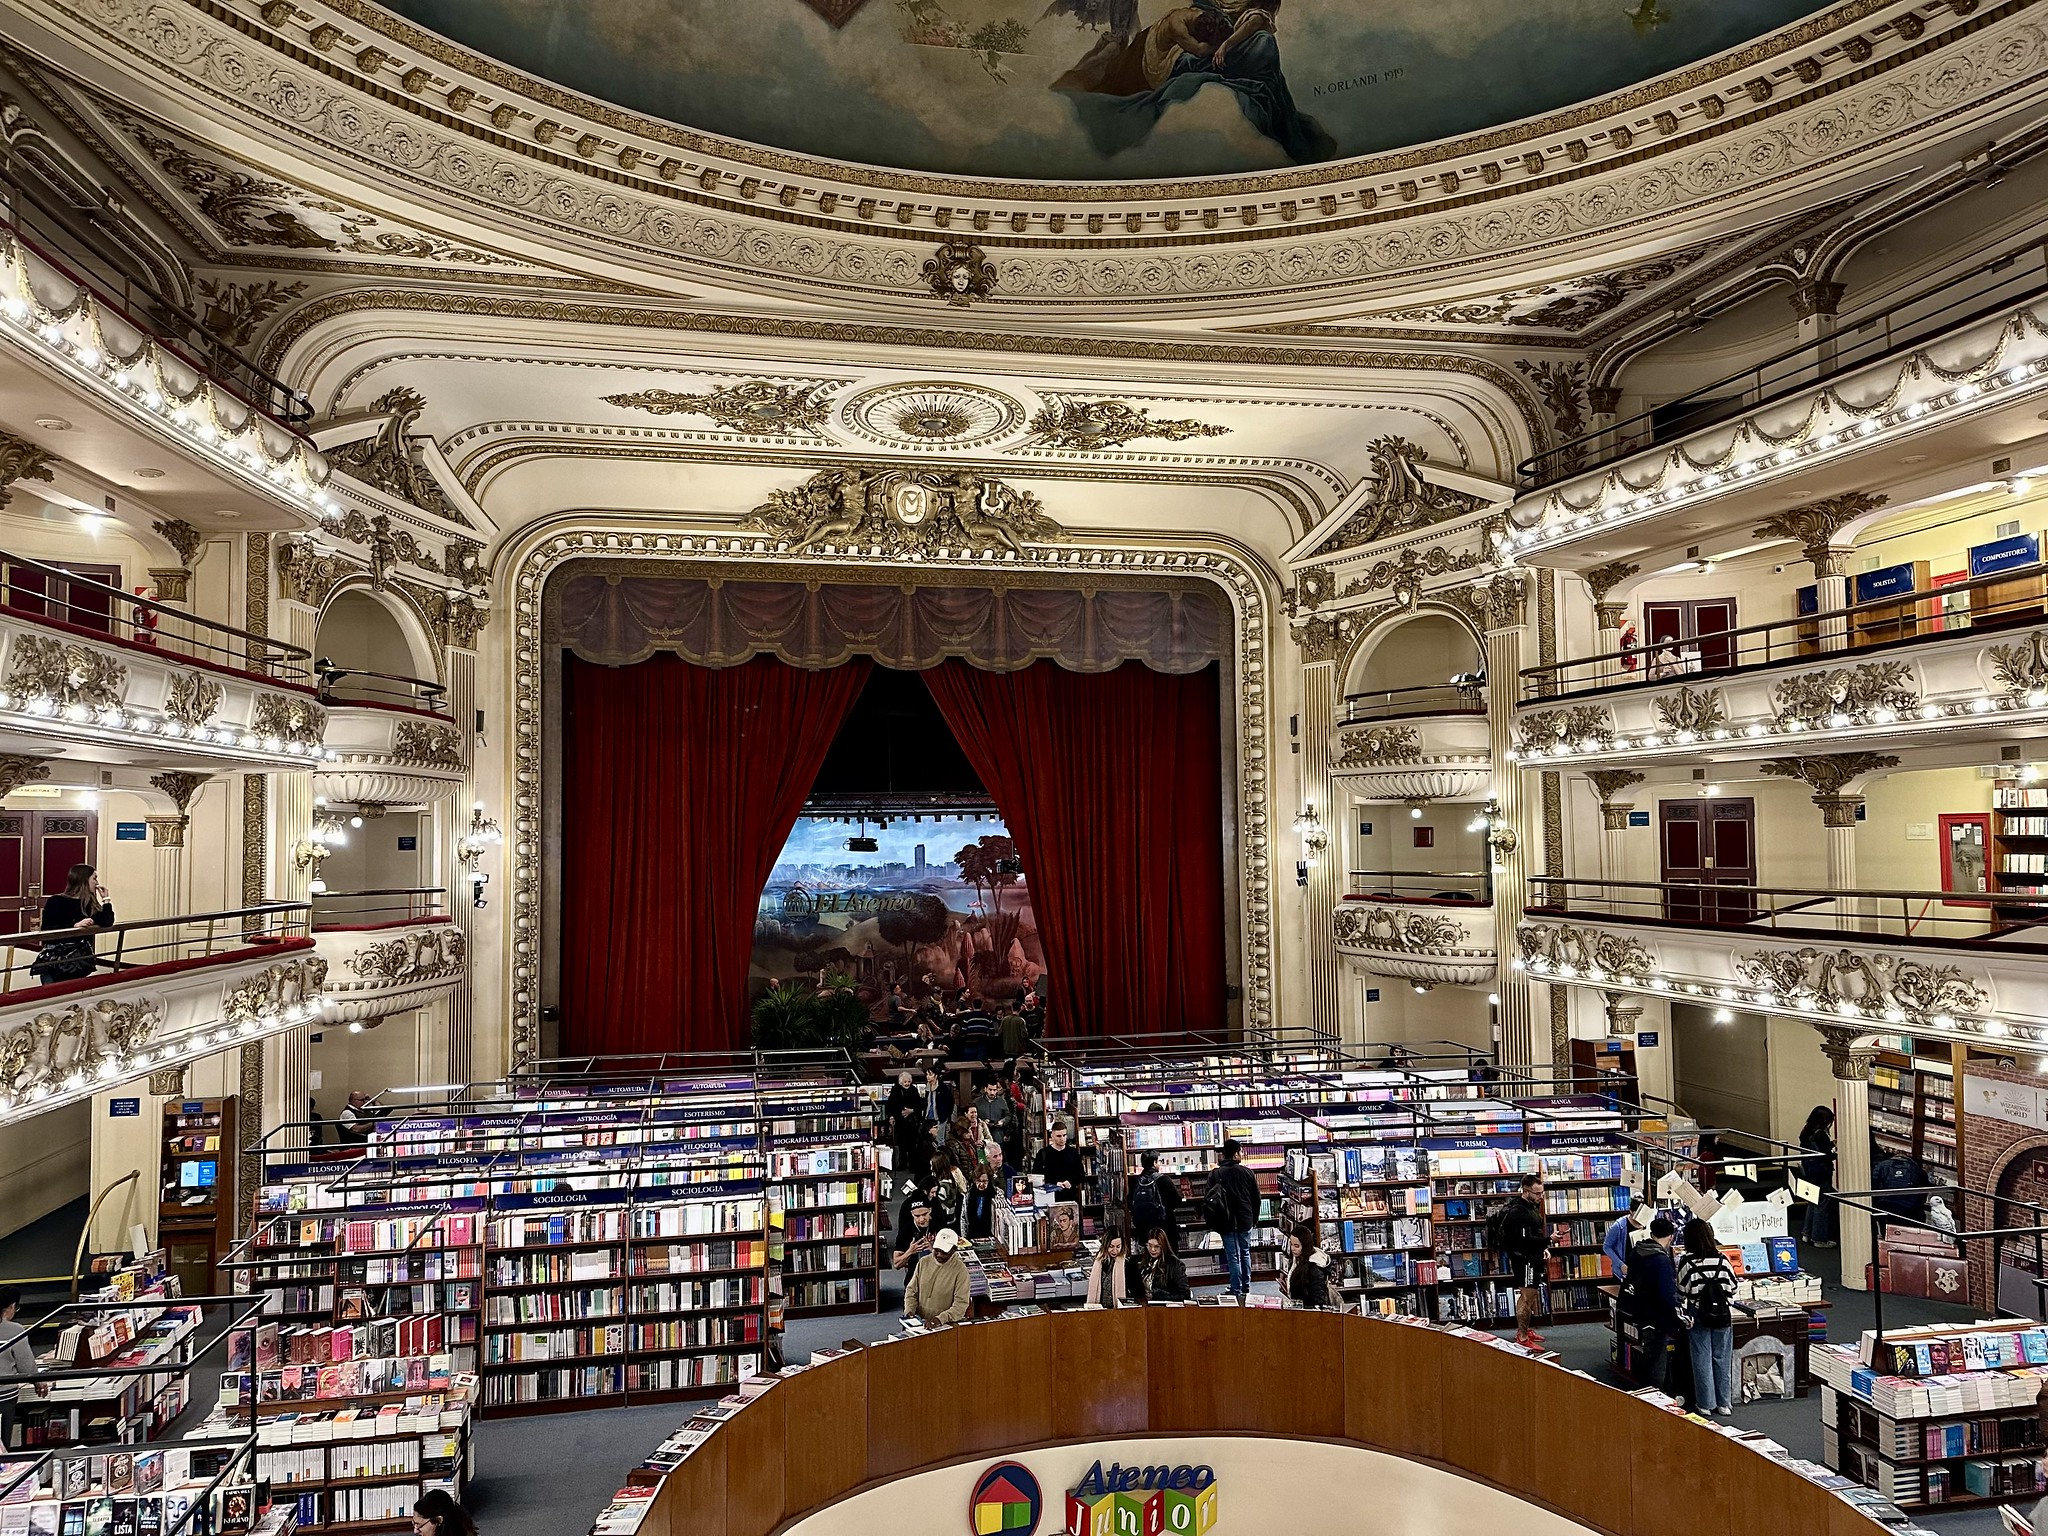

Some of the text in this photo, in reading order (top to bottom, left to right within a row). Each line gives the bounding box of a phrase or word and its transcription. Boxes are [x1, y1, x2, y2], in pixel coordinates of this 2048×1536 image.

[1313, 86, 1326, 97] N.
[1327, 73, 1378, 94] ORLANDI
[1981, 547, 2028, 563] COMPOSITORES
[1872, 577, 1897, 588] SOLISTAS
[813, 892, 917, 913] El Ateneo
[691, 1082, 727, 1090] AUTOAYUDA
[684, 1109, 726, 1118] ESOTERISMO
[787, 1104, 826, 1112] OCULTISMO
[576, 1114, 618, 1122] ASTROLOGÍA
[773, 1136, 809, 1145] BIOGRAFÍA
[820, 1133, 860, 1142] ESCRITORES
[1454, 1140, 1488, 1148] TURISMO
[1588, 1136, 1605, 1144] VIAJE
[671, 1185, 724, 1196] SOCIOLOGIA
[533, 1194, 588, 1204] SOCIOLOGIA
[1741, 1213, 1784, 1232] Harry Potter
[1071, 1459, 1216, 1499] Ateneo
[1070, 1492, 1215, 1536] Junior
[113, 1524, 133, 1535] LISTA
